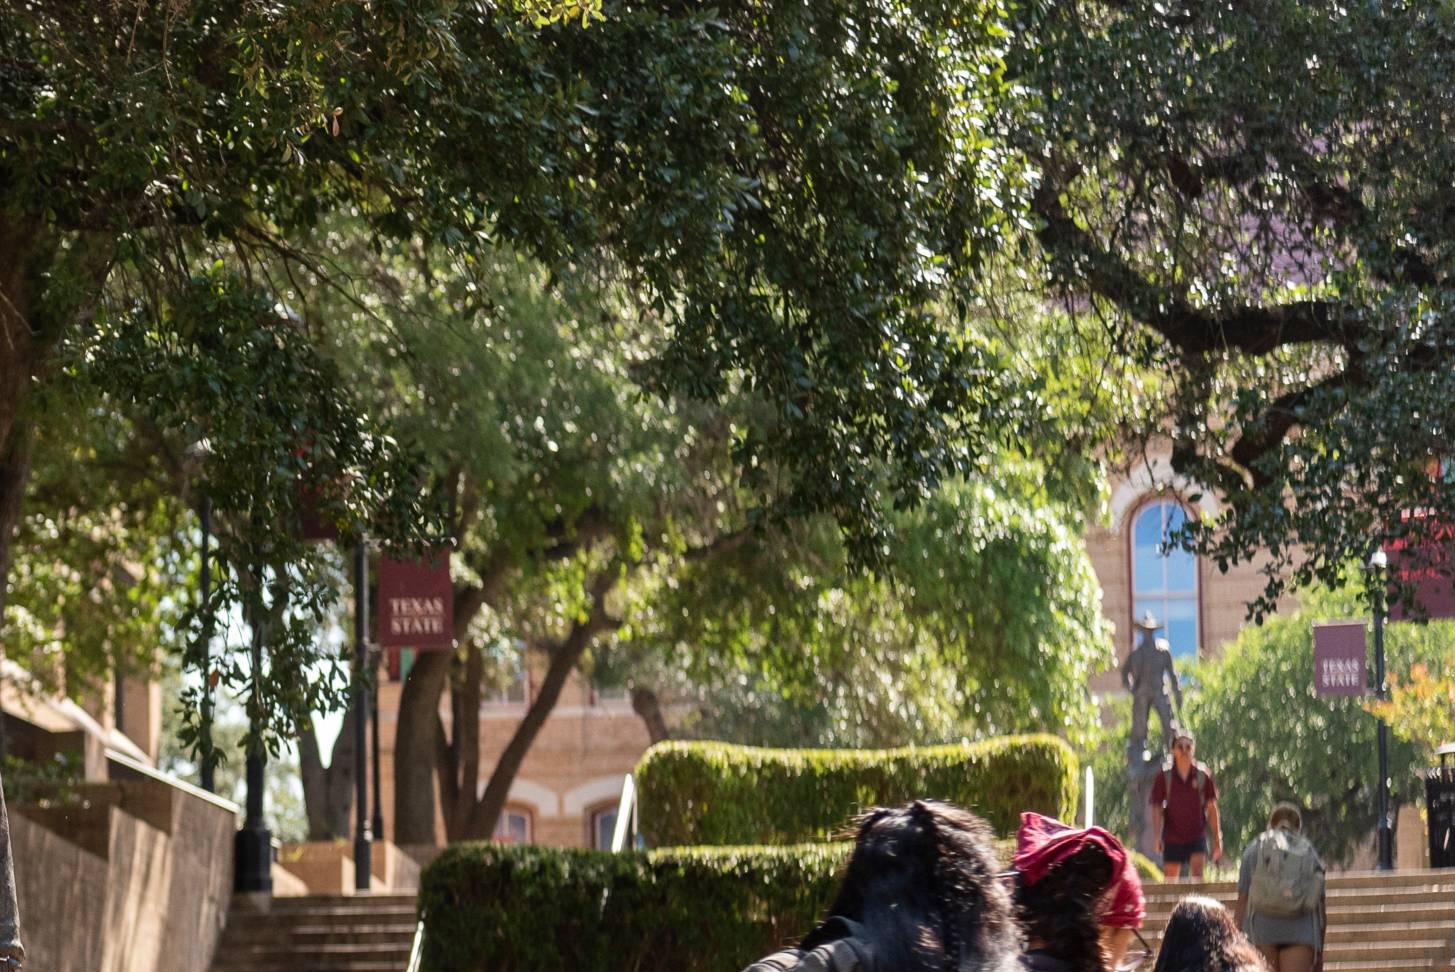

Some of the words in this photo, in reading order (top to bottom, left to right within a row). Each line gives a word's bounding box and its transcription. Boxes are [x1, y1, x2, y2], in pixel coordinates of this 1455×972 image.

[390, 598, 444, 616] TEXAS
[391, 617, 444, 635] STATE
[1322, 658, 1359, 673] TEXAS
[1322, 673, 1359, 688] STATE
